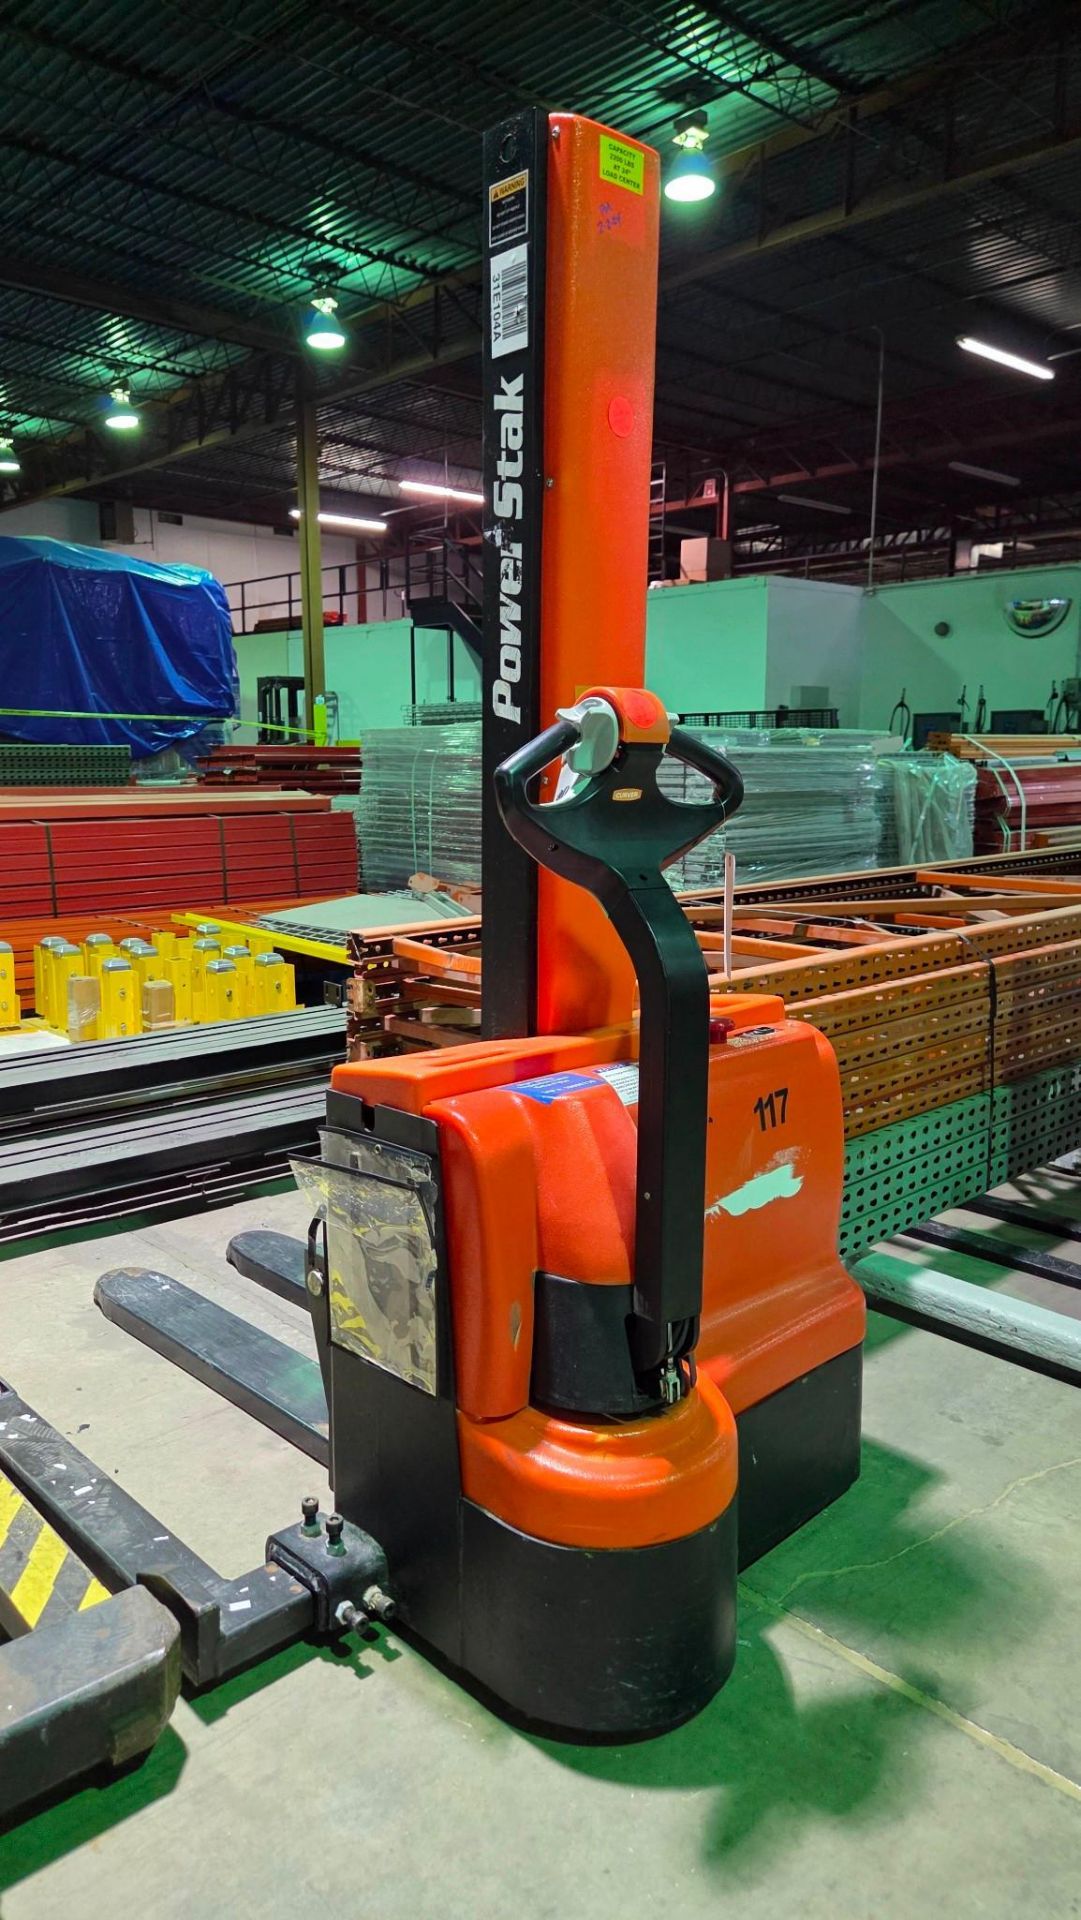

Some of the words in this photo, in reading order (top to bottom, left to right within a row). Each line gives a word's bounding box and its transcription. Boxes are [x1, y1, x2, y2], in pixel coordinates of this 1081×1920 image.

[608, 143, 636, 160] CAPACITY
[624, 159, 635, 169] LBS
[499, 177, 526, 196] WARNING
[602, 168, 618, 180] LOAD
[618, 175, 640, 189] CENTER
[492, 272, 502, 343] 31E104A
[754, 1087, 789, 1132] 117
